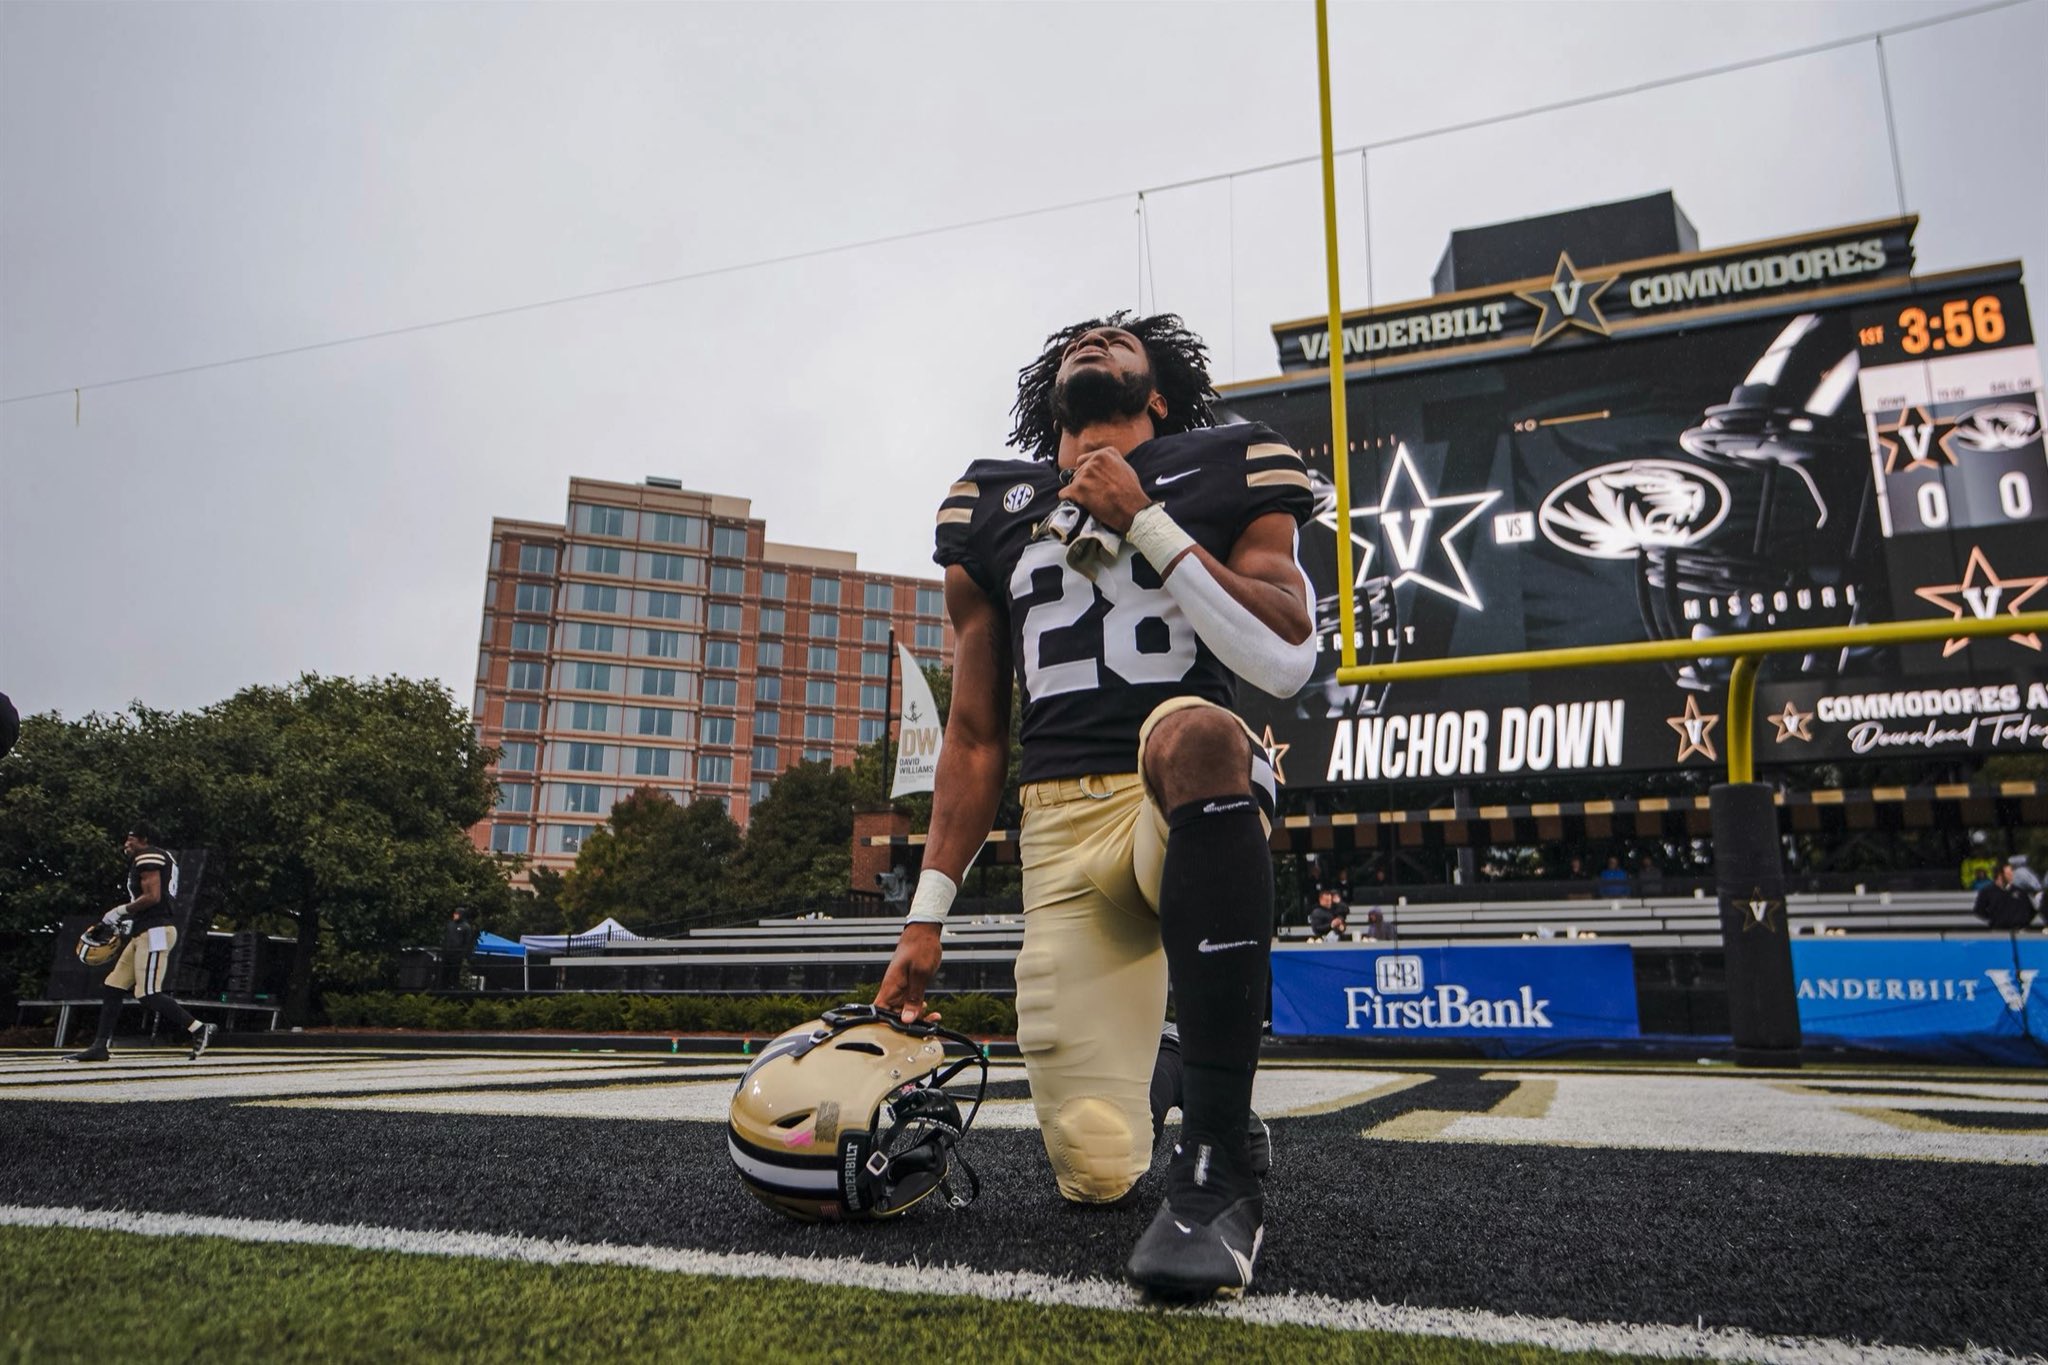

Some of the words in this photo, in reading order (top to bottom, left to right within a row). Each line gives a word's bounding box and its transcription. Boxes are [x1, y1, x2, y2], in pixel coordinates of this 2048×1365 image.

[1552, 281, 1583, 315] V
[1630, 239, 1887, 308] COMMODORES
[1899, 295, 2006, 354] 3:56
[1898, 423, 1934, 461] V
[1917, 481, 1949, 528] 0
[1999, 471, 2033, 519] 0
[1380, 508, 1432, 571] V
[1506, 518, 1522, 537] VS
[1010, 538, 1198, 703] 28
[1683, 584, 1856, 620] MISSOURI
[1316, 625, 1415, 652] ERBILT
[1816, 684, 2021, 722] COMMODORES
[2026, 682, 2048, 711] A
[902, 727, 938, 757] DW
[1326, 709, 1488, 782] ANCHOR
[1499, 699, 1625, 773] DOWN
[1847, 717, 1979, 754] Download
[900, 758, 920, 766] DAVID
[900, 765, 934, 775] WILLIAMS
[1343, 984, 1553, 1029] FirstBank
[1797, 978, 1979, 1001] ANDERBILT
